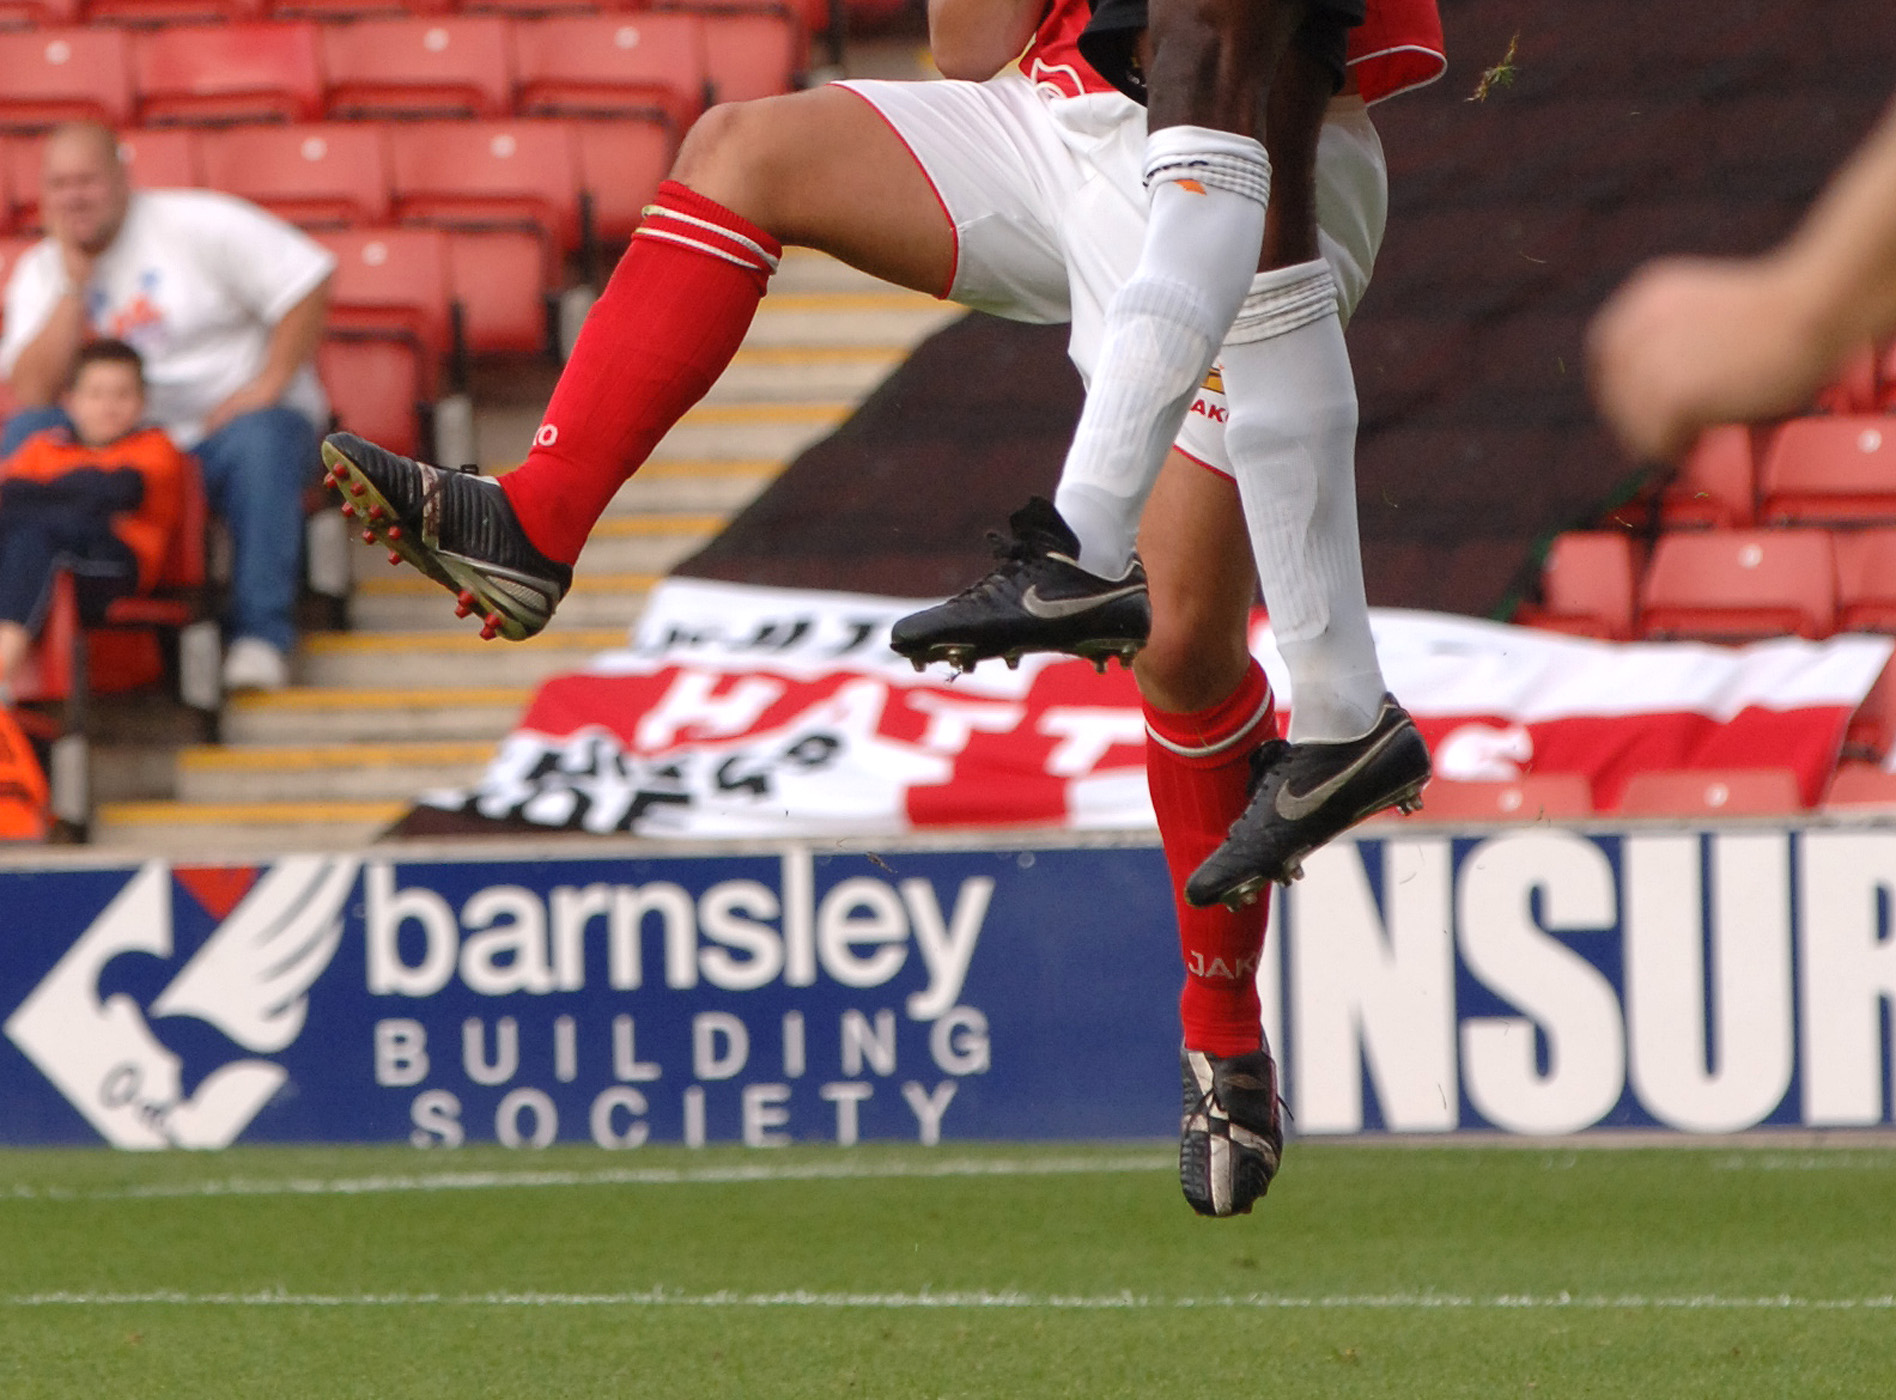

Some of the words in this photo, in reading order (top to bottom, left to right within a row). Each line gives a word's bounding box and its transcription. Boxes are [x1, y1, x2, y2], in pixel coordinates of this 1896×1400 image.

[364, 850, 996, 1021] barnsley
[375, 1005, 991, 1087] BUILDING
[410, 1080, 957, 1150] SOCIETY
